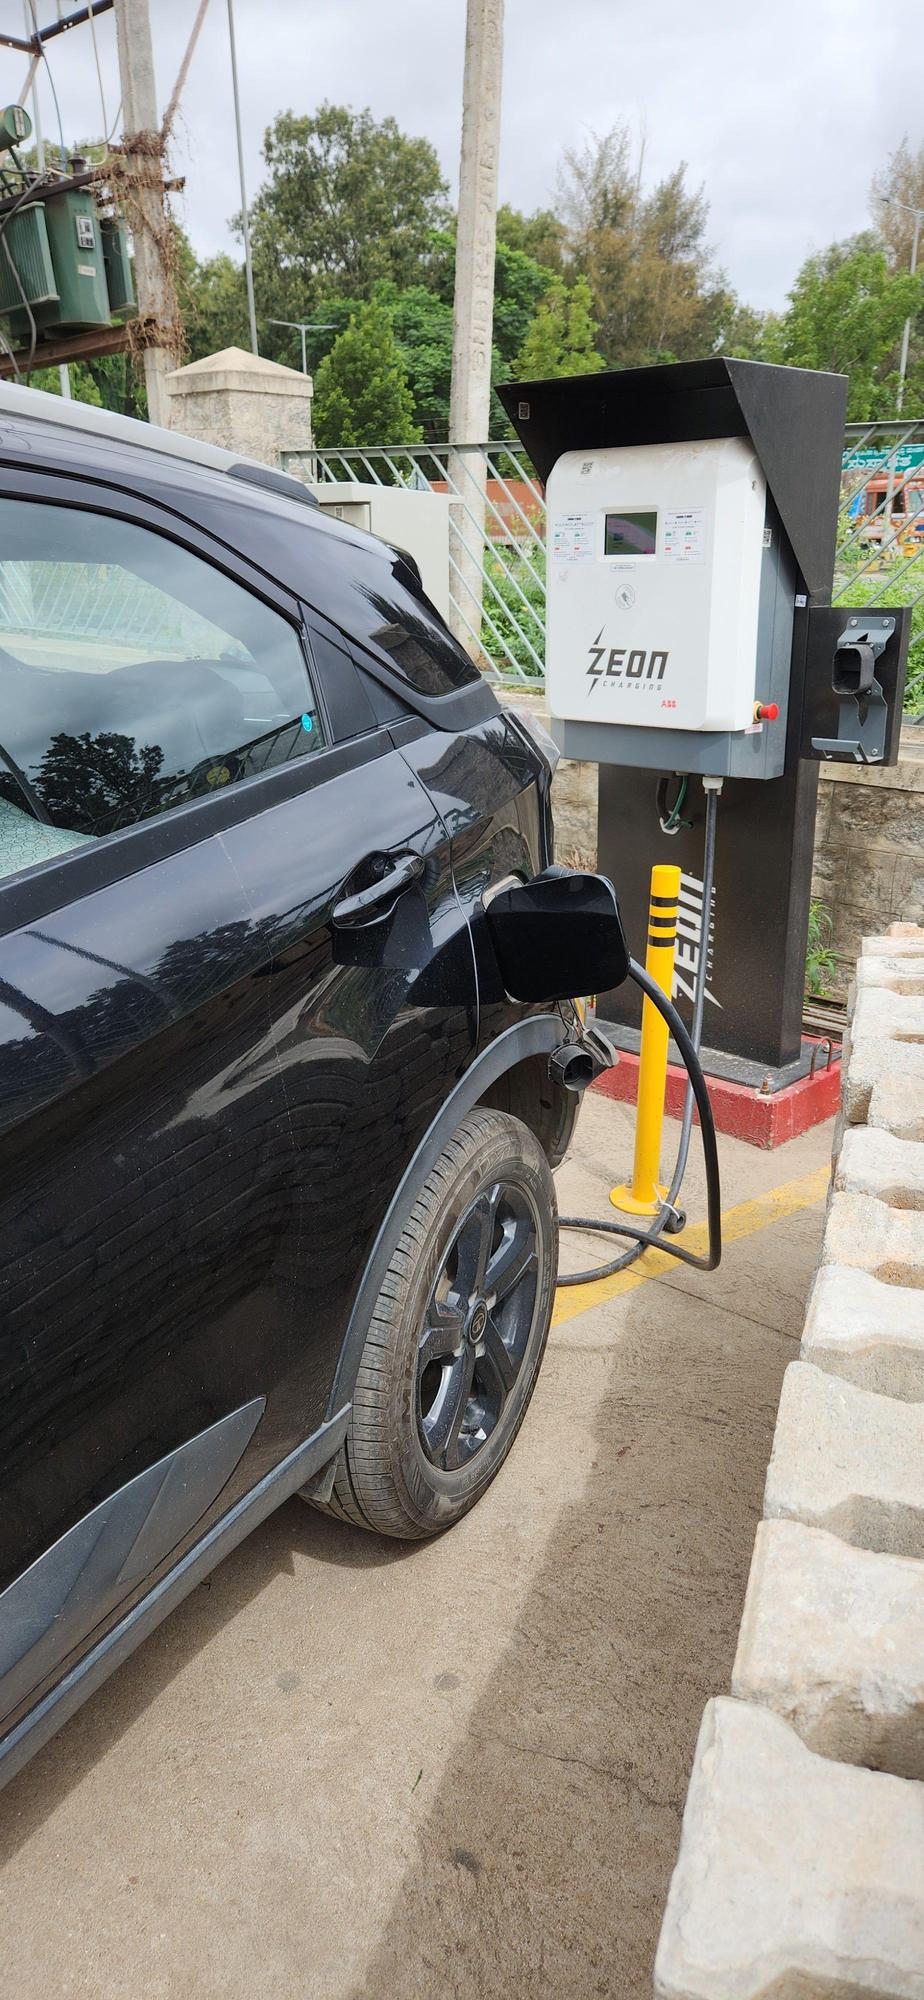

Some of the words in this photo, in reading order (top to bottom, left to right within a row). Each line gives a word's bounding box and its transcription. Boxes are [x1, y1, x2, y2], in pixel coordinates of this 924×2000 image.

[586, 647, 669, 680] ZEON
[602, 680, 662, 691] CHARGING
[661, 700, 677, 708] ABB
